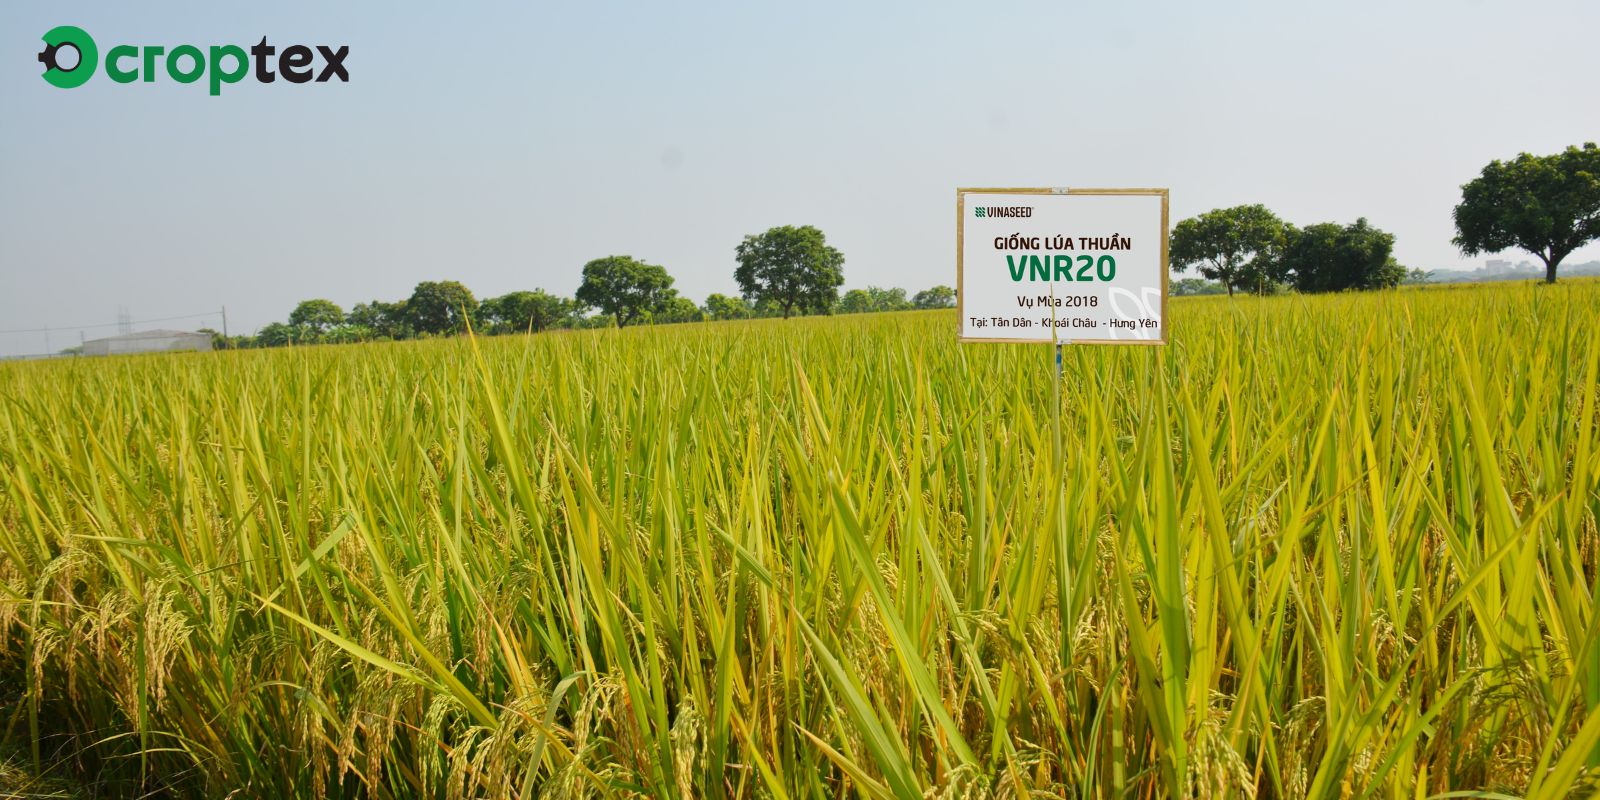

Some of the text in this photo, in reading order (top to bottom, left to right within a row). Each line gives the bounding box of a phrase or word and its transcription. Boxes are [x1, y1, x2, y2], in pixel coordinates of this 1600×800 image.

[987, 206, 1032, 218] VINASEED
[994, 232, 1040, 250] GIỐNG
[1045, 234, 1074, 250] LÚA
[1006, 255, 1116, 282] VNR20
[1017, 295, 1034, 309] Vụ
[1065, 295, 1098, 307] 2018
[970, 317, 988, 328] Tại:
[990, 317, 1010, 327] Tân
[1012, 317, 1032, 327] Dân
[1072, 317, 1097, 328] Châu
[1109, 318, 1136, 330] Hưng
[1138, 318, 1158, 328] Yên
